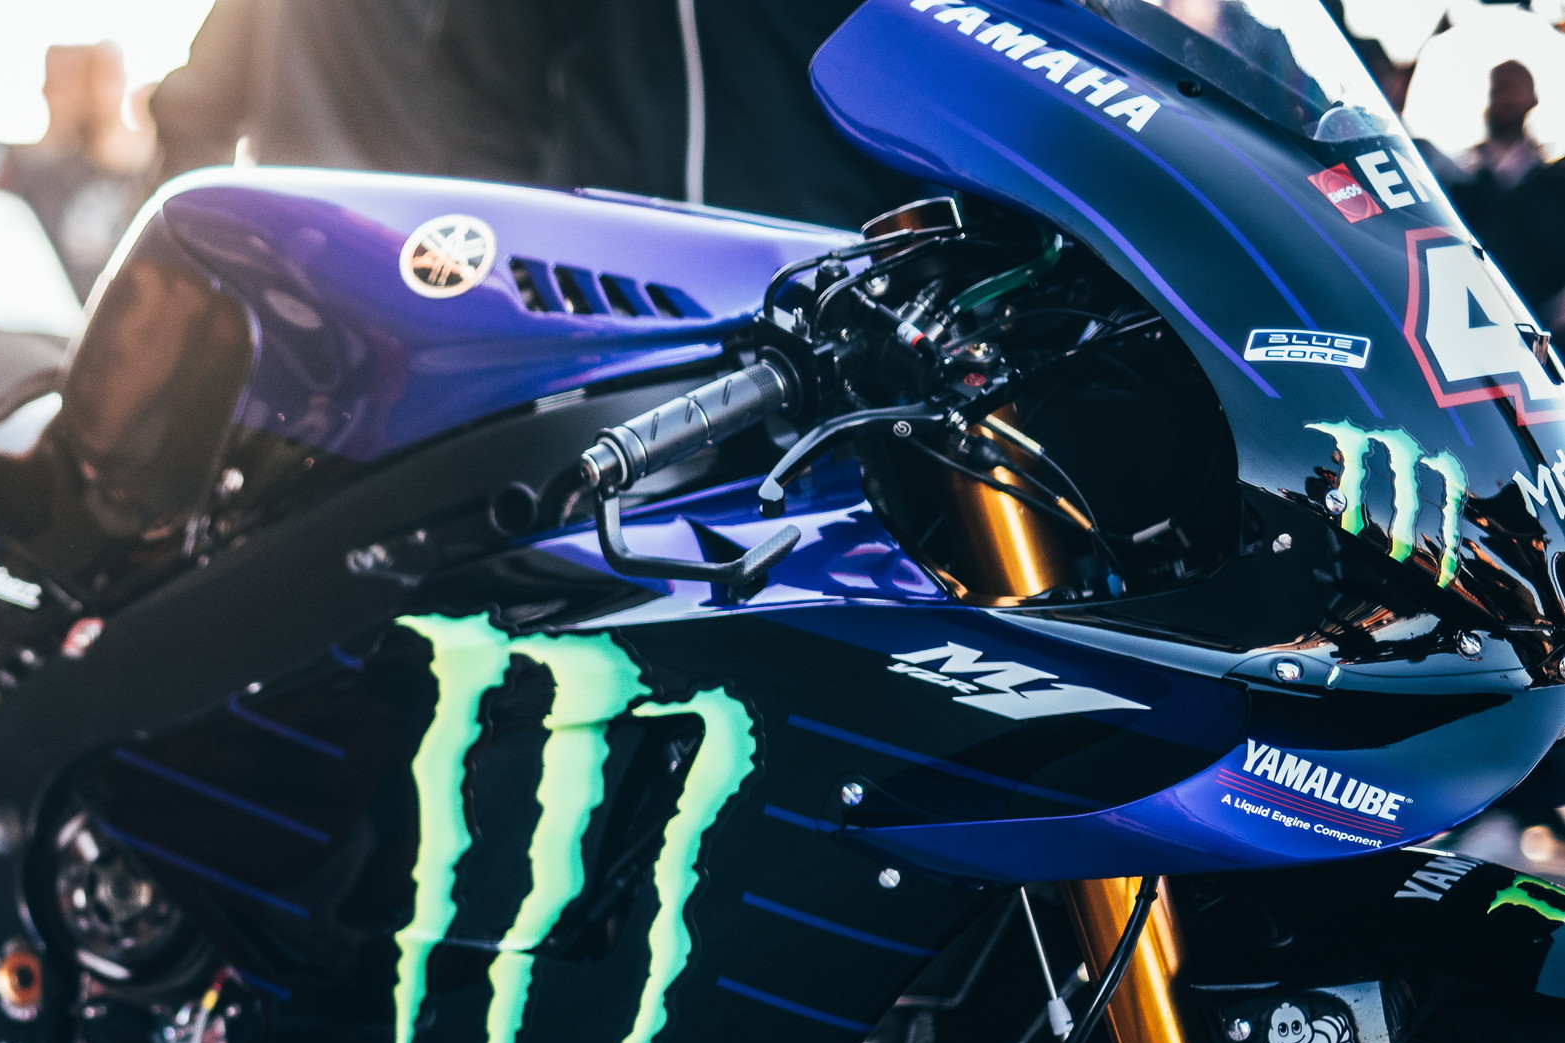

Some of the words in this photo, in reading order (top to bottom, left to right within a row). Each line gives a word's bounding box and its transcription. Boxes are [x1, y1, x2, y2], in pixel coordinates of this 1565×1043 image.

[1328, 183, 1363, 204] ENEOS
[1268, 333, 1353, 350] BLUE
[1264, 349, 1349, 364] CORE
[1221, 793, 1232, 806] A
[1234, 797, 1271, 817] Liquid
[1271, 810, 1311, 830] Engine
[1313, 823, 1384, 849] Component
